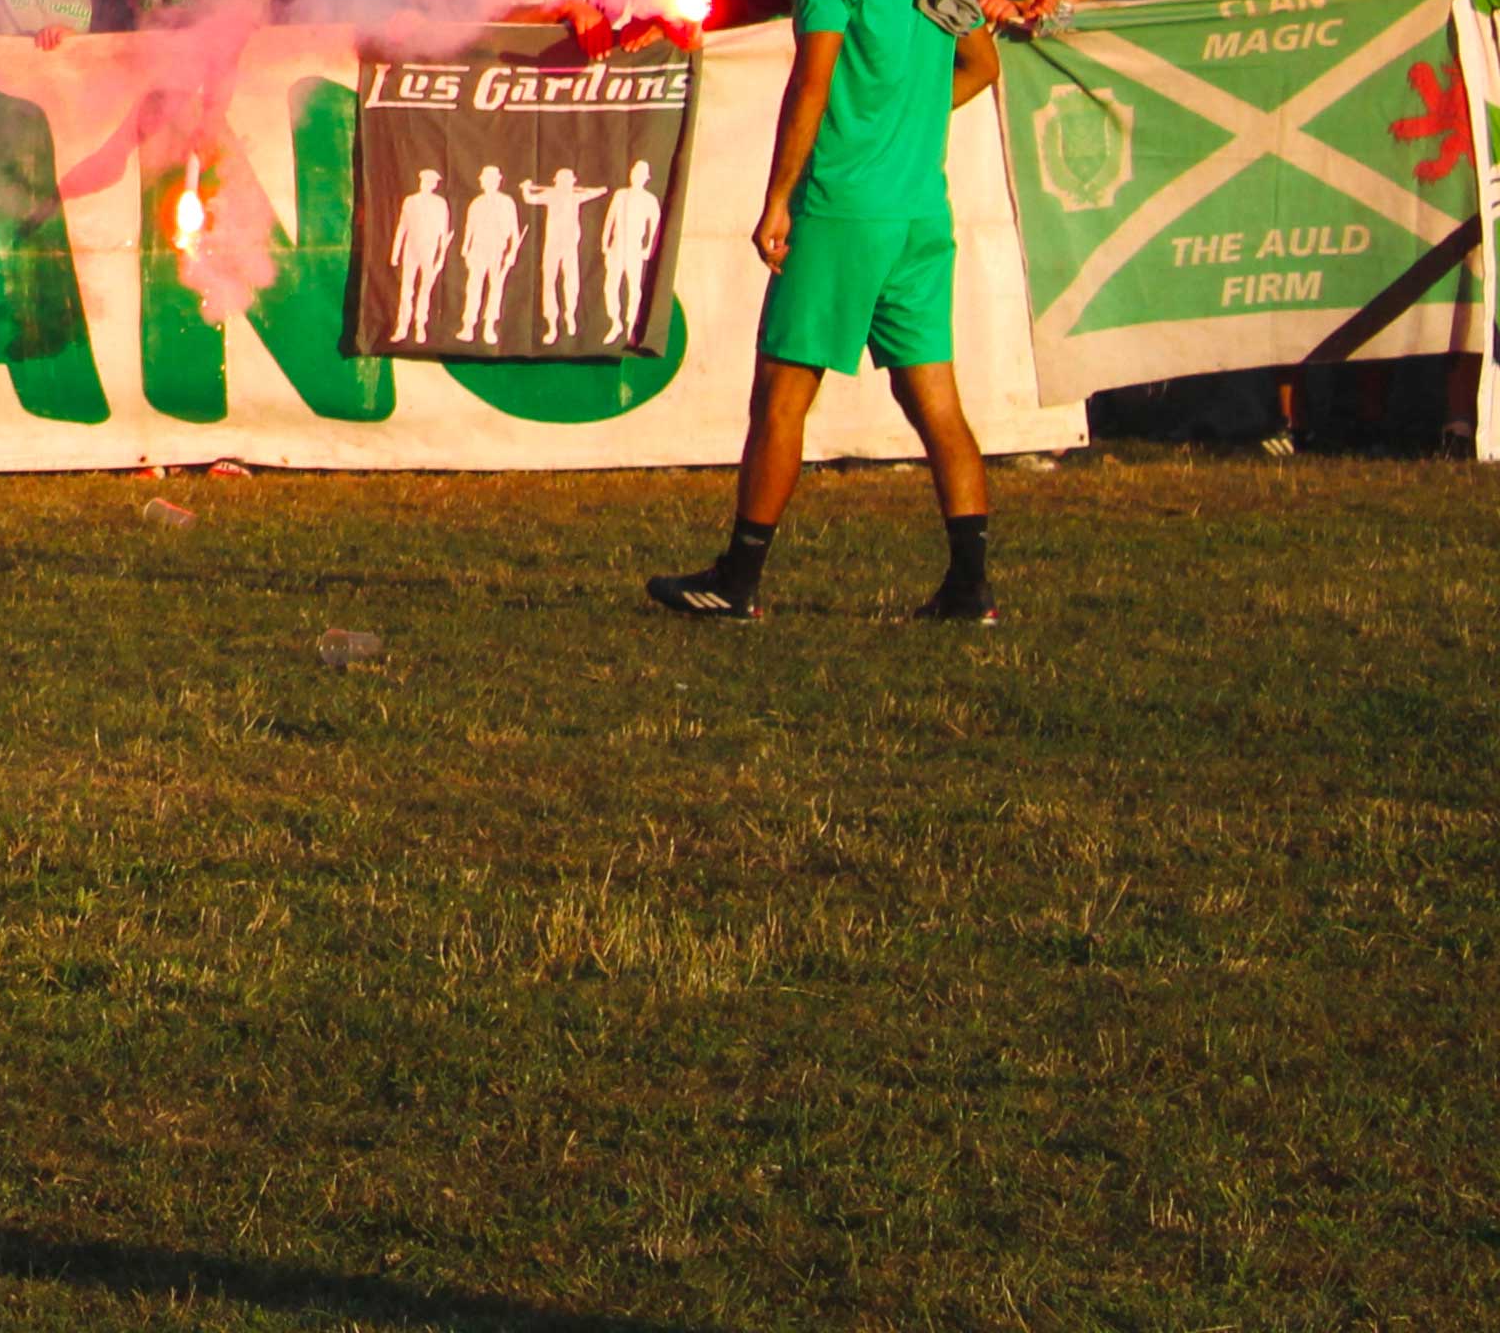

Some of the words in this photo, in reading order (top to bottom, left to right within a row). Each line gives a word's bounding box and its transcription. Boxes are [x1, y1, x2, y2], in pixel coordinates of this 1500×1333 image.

[1202, 17, 1344, 62] MAGIC
[1171, 232, 1245, 268] THE
[1255, 224, 1372, 259] AULD
[1221, 270, 1325, 308] FIRM
